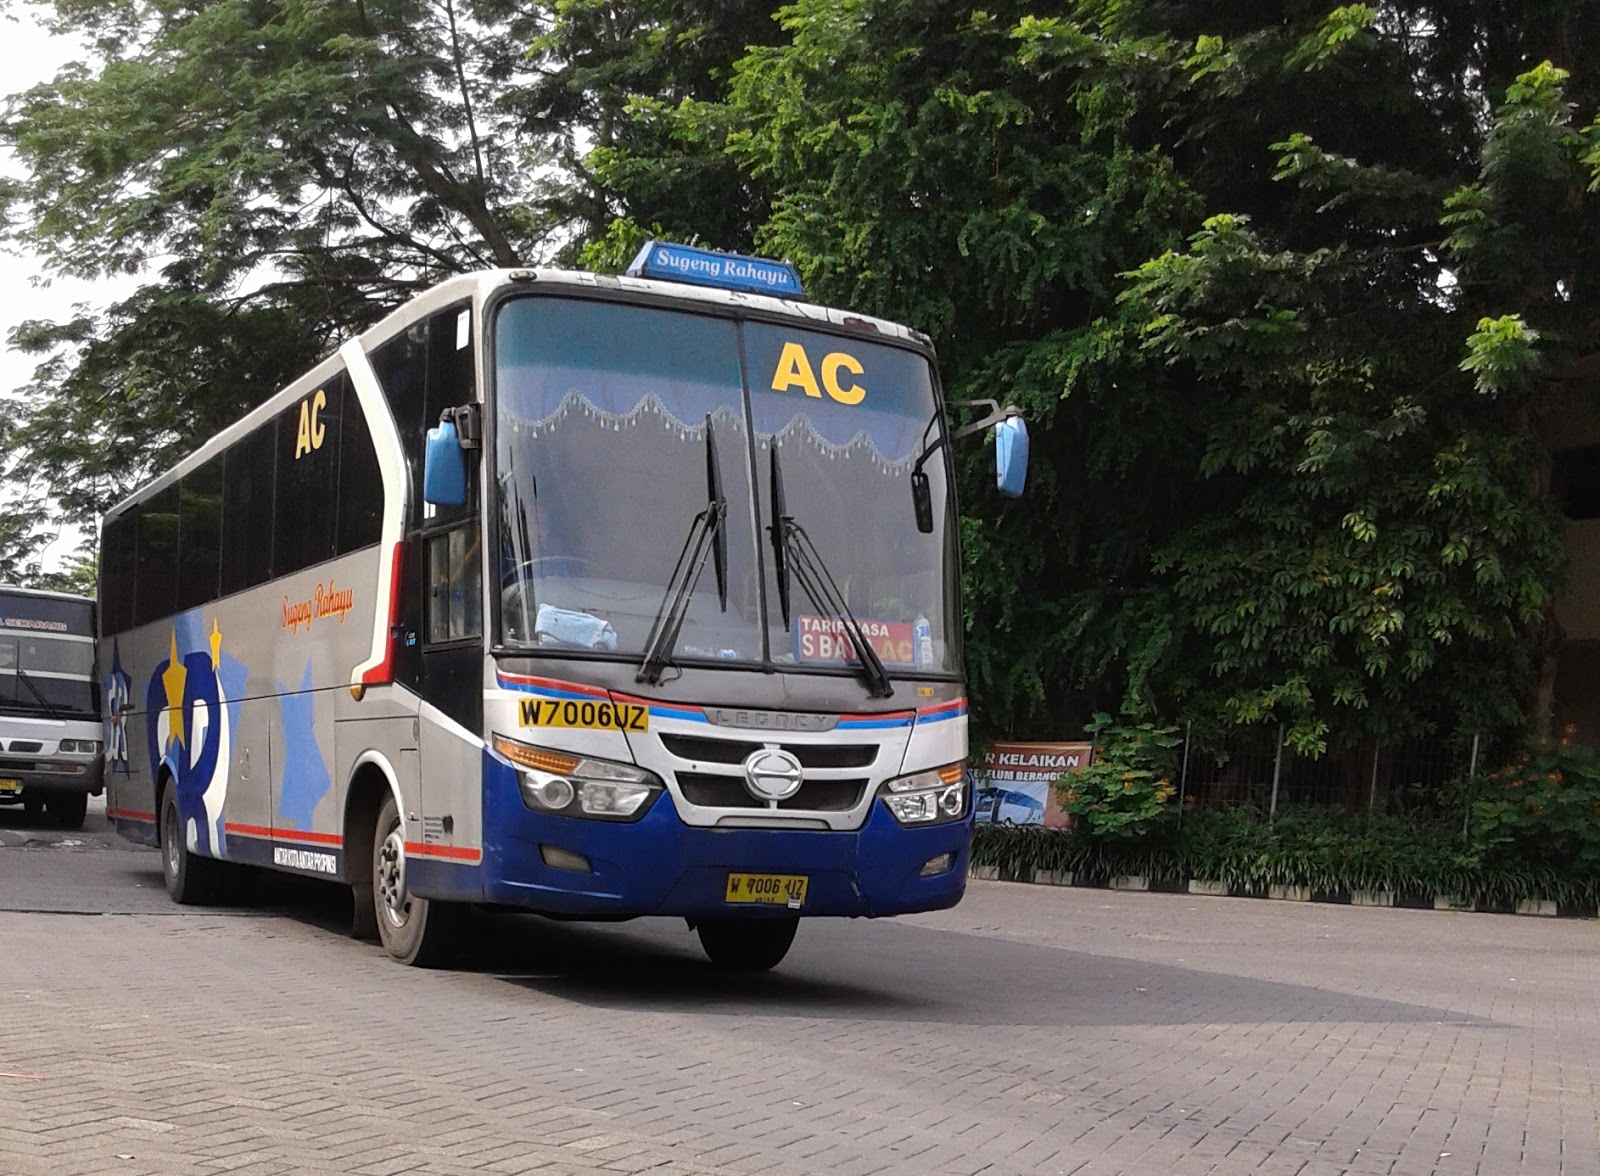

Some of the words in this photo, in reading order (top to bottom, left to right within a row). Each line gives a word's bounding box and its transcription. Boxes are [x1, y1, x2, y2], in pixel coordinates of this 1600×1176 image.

[656, 250, 720, 275] Sugeng
[723, 261, 788, 286] Rahayu
[771, 342, 867, 405] AC
[295, 389, 327, 460] AC
[282, 595, 312, 636] Sugeng
[314, 580, 354, 624] Rahayu
[5, 617, 68, 631] SEMARANG
[880, 639, 913, 662] AC
[520, 701, 647, 730] W7006UZ
[717, 710, 828, 728] LEGACY
[998, 752, 1079, 768] KELAIKAN
[730, 878, 741, 894] W
[747, 877, 782, 895] 7006
